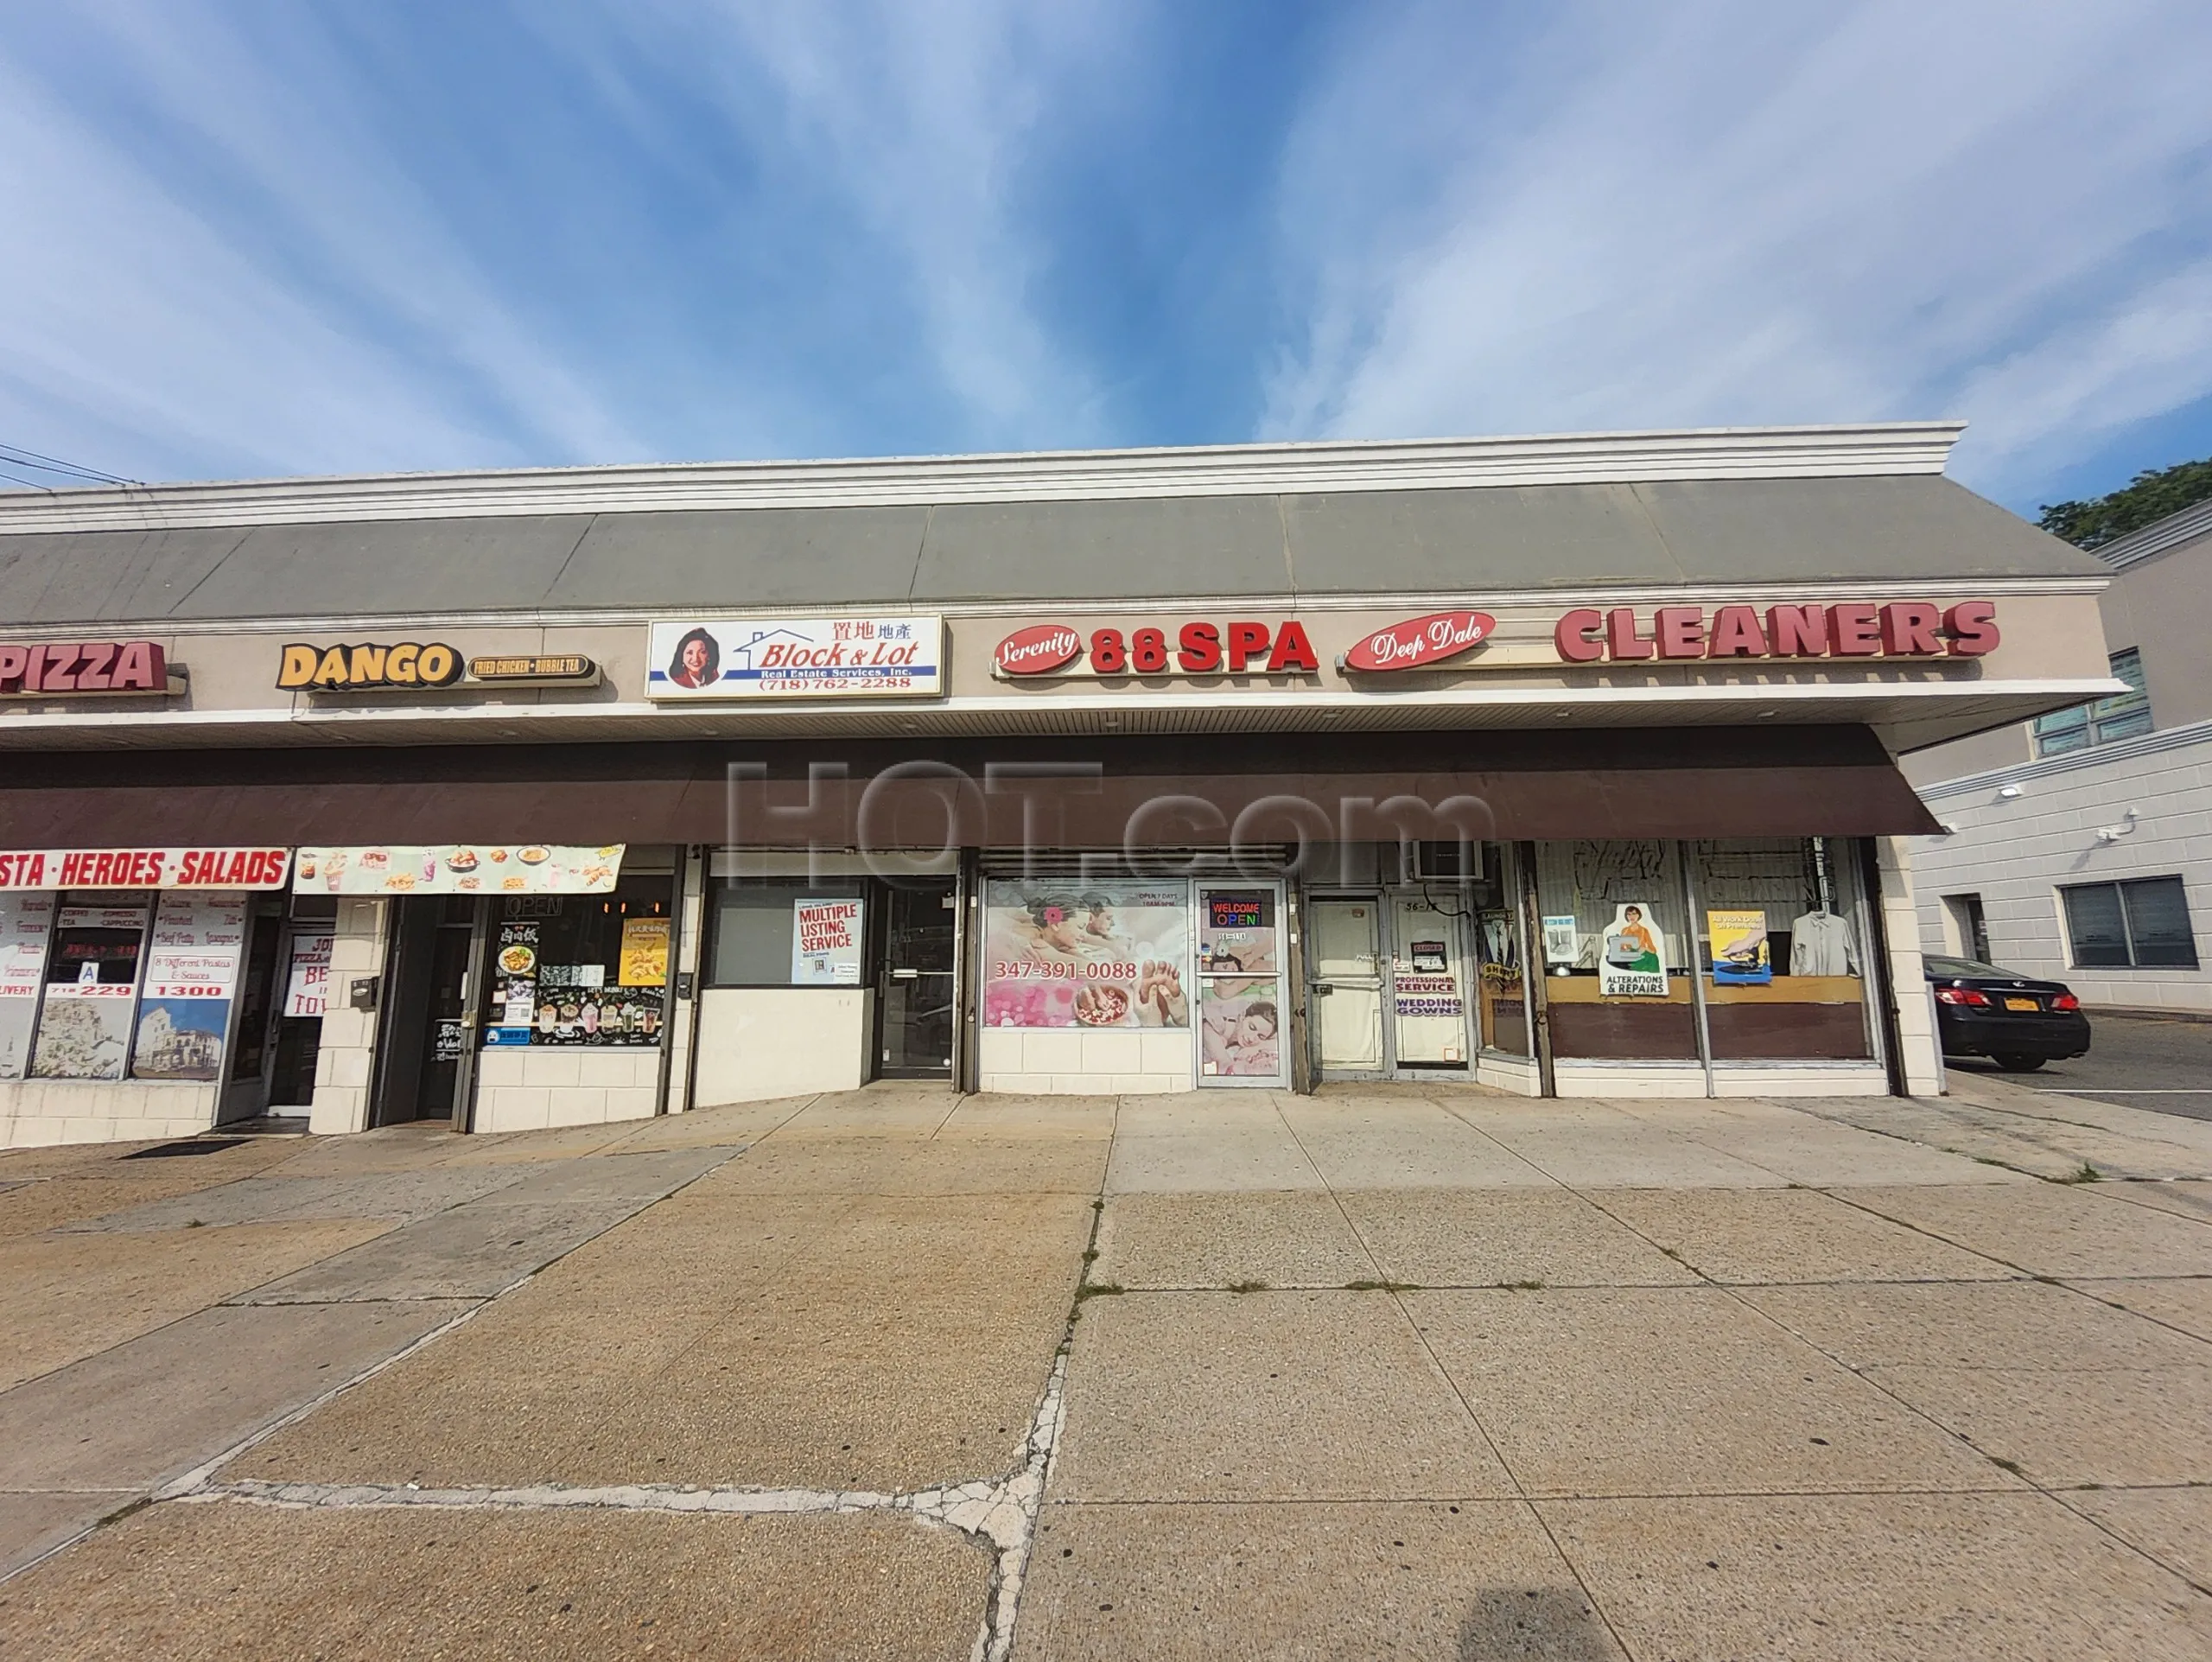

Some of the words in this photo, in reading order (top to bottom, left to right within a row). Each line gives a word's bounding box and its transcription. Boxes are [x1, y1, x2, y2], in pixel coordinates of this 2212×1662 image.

[1370, 633, 1425, 665] Deep
[1427, 614, 1483, 651] Dale
[1556, 601, 2001, 663] CLEANERS
[759, 642, 849, 668] Block
[849, 649, 868, 665] &
[869, 640, 919, 665] Lot
[995, 632, 1077, 665] Serenity
[1090, 627, 1168, 673] 88
[1177, 621, 1320, 672] SPA
[0, 641, 164, 692] PIZZA
[276, 642, 458, 689] DANGO
[474, 660, 495, 674] FRIED
[496, 659, 530, 673] CHICKEN
[535, 659, 565, 672] BUBBLE
[566, 658, 579, 672] TEA
[760, 670, 786, 679] Real
[790, 669, 827, 678] Estate
[832, 668, 885, 678] Services,
[759, 679, 809, 691] (718)
[812, 678, 912, 690] 762-2288
[58, 851, 165, 886] HEROES
[177, 850, 286, 884] SALADS
[507, 896, 563, 915] OPEN
[799, 903, 857, 923] MULTIPLE
[1213, 903, 1260, 914] WELCOME
[801, 920, 846, 938] LISTING
[1217, 914, 1256, 926] OPEN
[802, 933, 852, 952] SERVICE
[82, 966, 94, 980] A
[995, 961, 1138, 980] 347-391-0088
[1485, 965, 1517, 977] SHIRT
[1606, 975, 1663, 984] ALTERATIONS
[79, 986, 132, 996] 229
[156, 986, 222, 996] 1300
[1607, 984, 1617, 993] &
[1618, 984, 1664, 994] REPAIRS
[1396, 998, 1463, 1007] WEDDING
